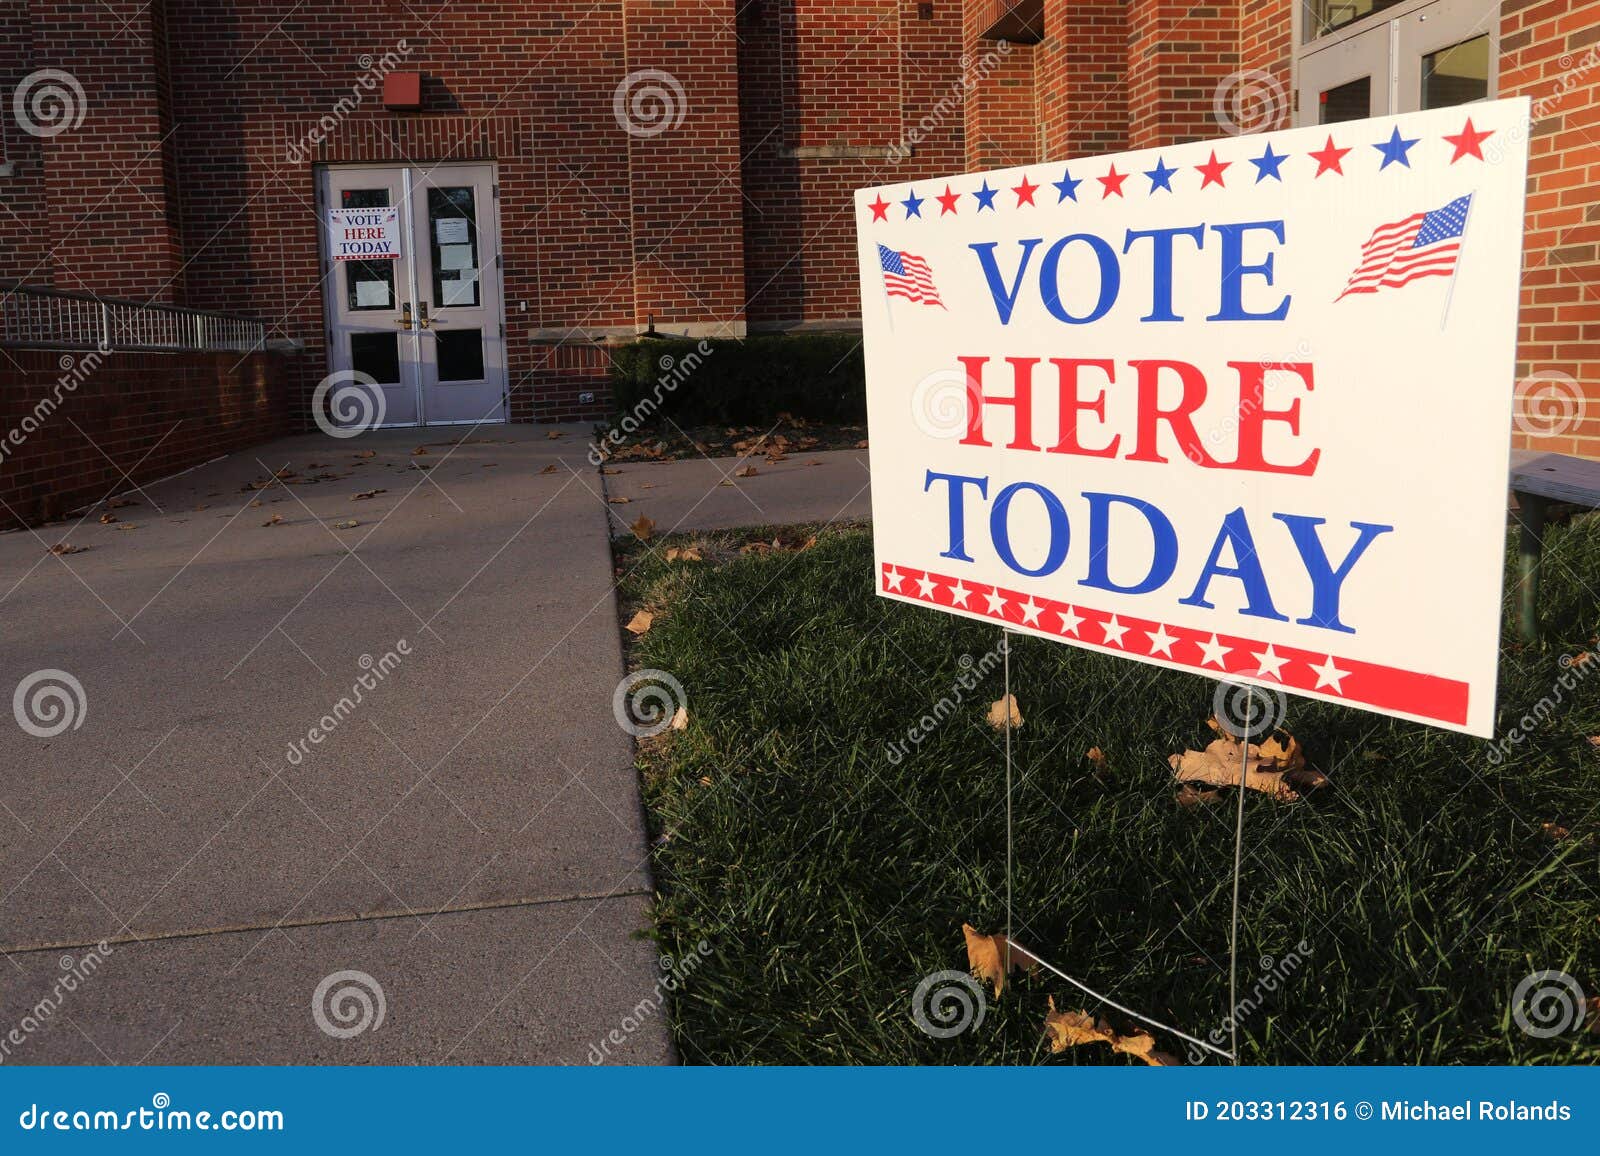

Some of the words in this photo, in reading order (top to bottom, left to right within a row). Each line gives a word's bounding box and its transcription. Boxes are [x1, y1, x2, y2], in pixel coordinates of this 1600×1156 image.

[340, 241, 392, 254] TODAY
[344, 227, 386, 240] HERE
[346, 214, 382, 226] VOTE
[968, 219, 1292, 326] VOTE
[957, 356, 1321, 476] HERE
[923, 468, 1394, 635] TODAY
